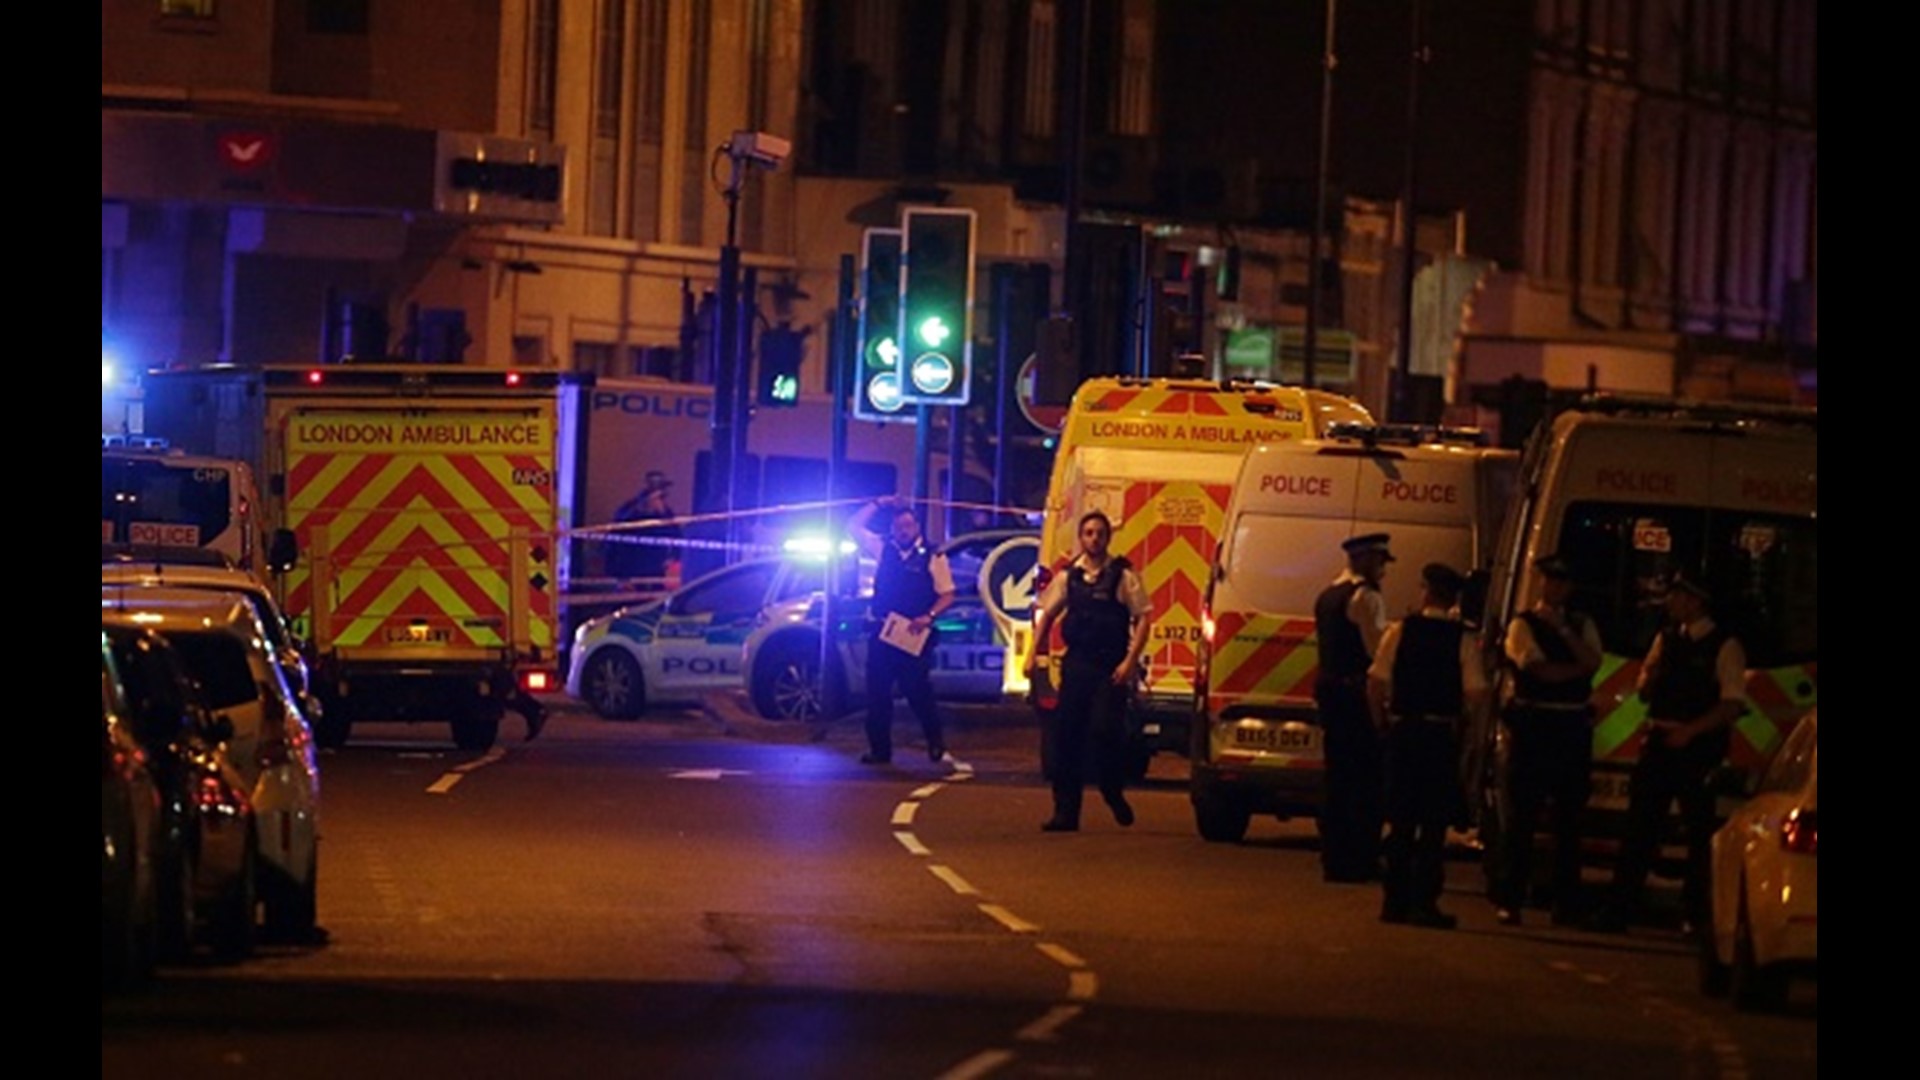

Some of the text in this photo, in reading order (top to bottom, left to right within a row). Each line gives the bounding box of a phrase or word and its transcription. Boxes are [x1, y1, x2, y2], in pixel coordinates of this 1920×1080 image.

[594, 391, 714, 419] POLIC
[300, 424, 540, 445] LONDON AMBULANCE
[1091, 421, 1167, 441] LONDON
[513, 468, 550, 485] NHS
[1259, 474, 1333, 497] POLICE
[1596, 468, 1677, 497] POLICE
[1381, 480, 1457, 504] POLICE
[132, 524, 198, 544] POLICE
[1636, 530, 1667, 548] ICE
[662, 656, 740, 675] POL
[940, 650, 1003, 671] LIC
